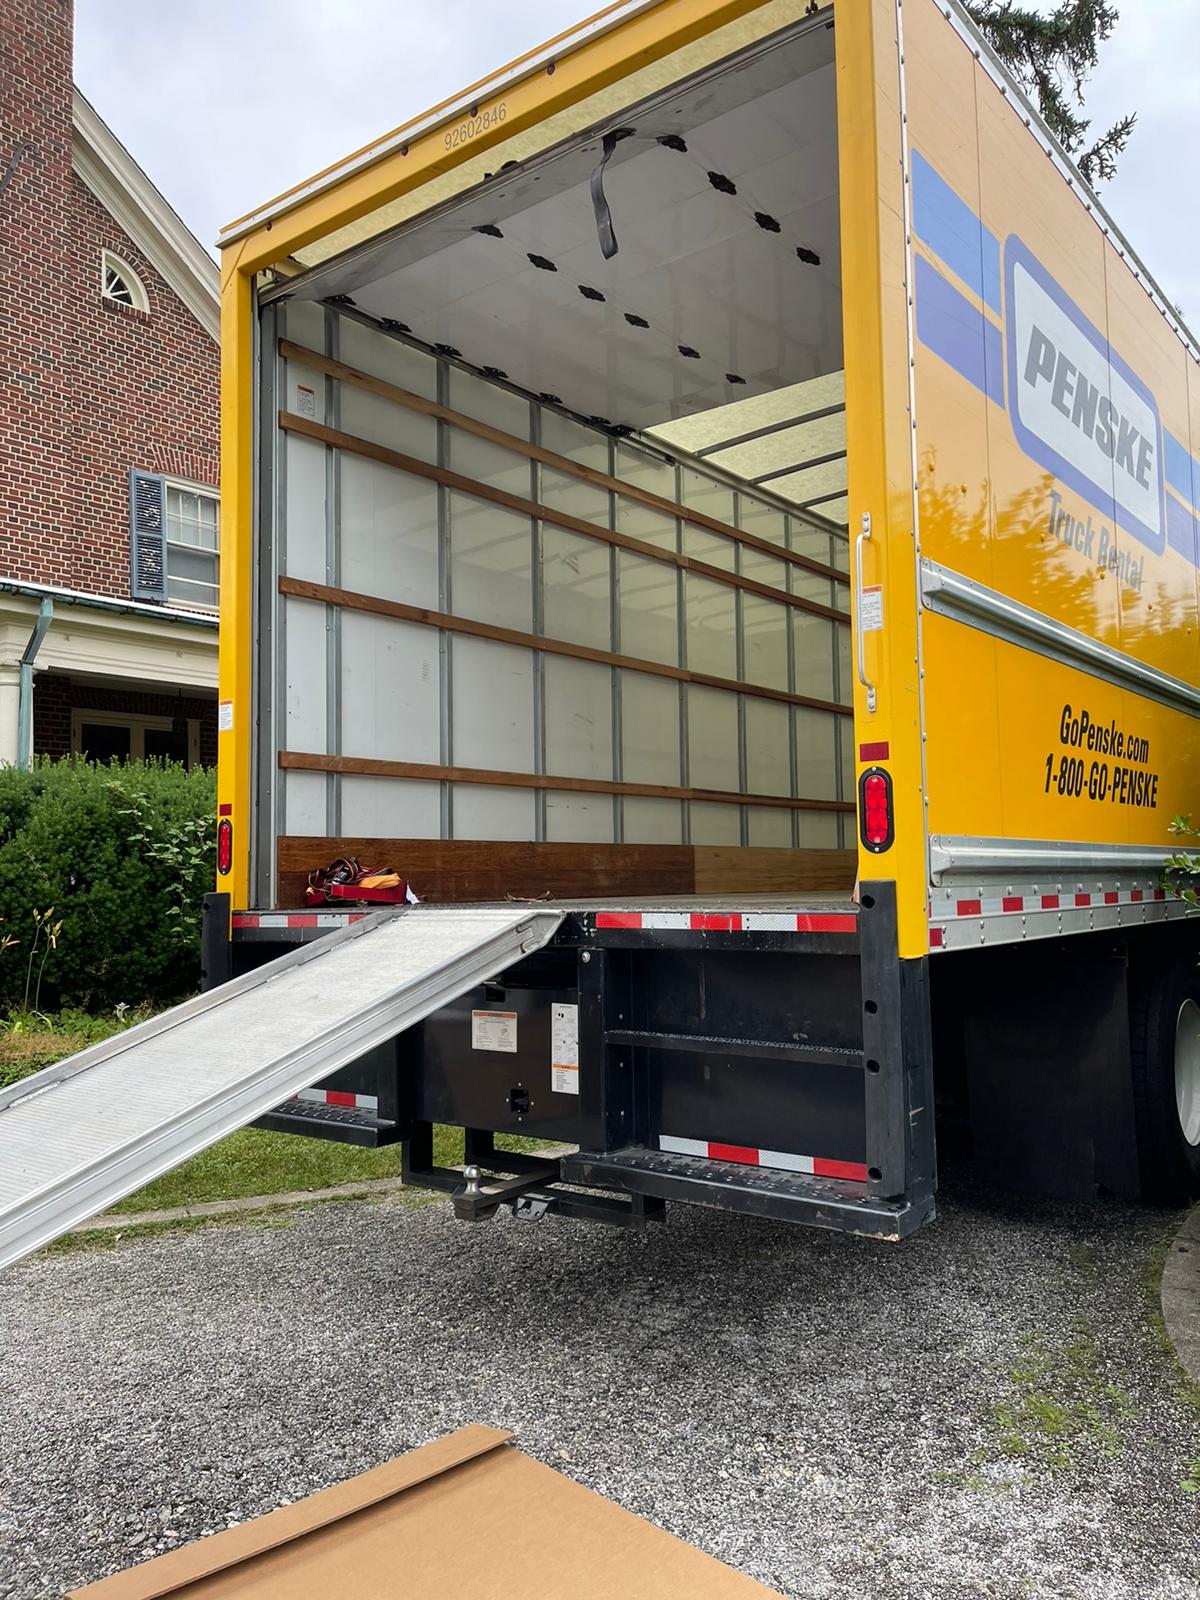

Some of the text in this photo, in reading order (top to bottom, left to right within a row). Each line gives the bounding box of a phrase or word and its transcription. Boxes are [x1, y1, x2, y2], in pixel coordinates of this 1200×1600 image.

[444, 103, 507, 151] 92602846
[1024, 324, 1154, 490] PENSKE
[1048, 489, 1145, 593] Truck Rental
[1059, 704, 1149, 764] GoPenske.com
[1045, 753, 1159, 808] 1-800-GO-PENSKE
